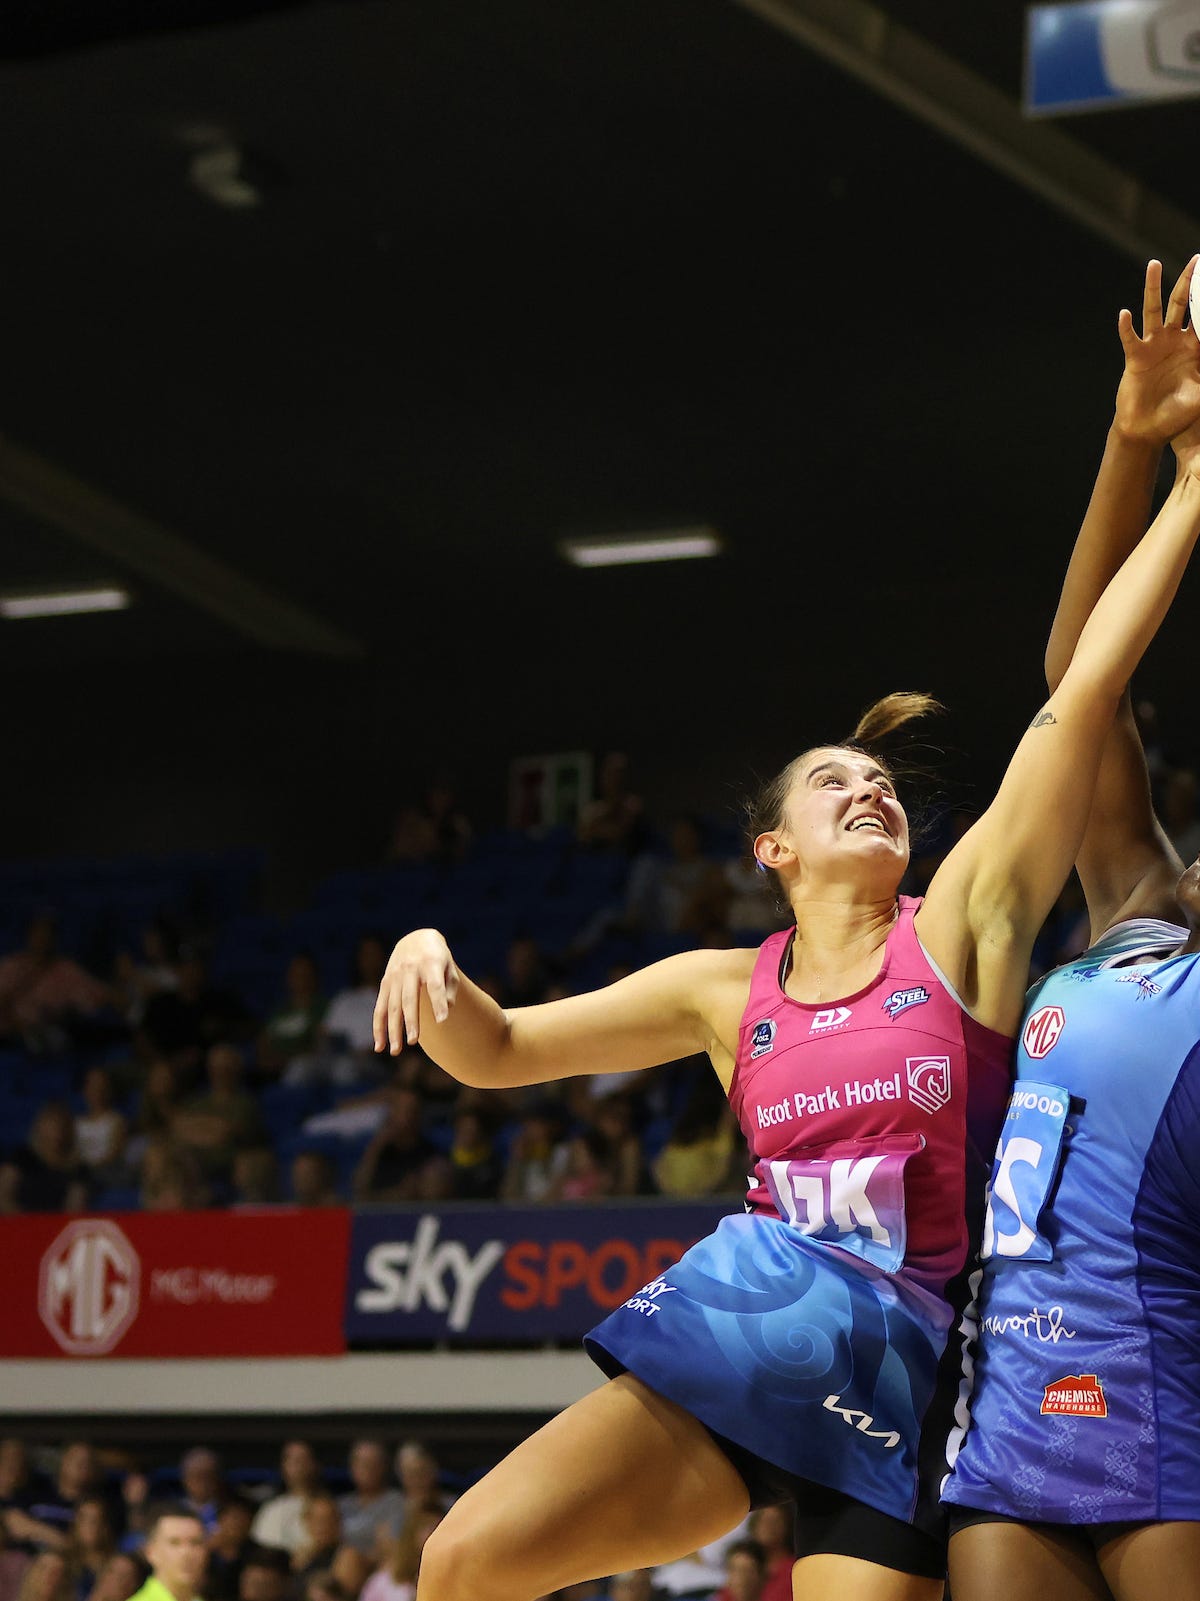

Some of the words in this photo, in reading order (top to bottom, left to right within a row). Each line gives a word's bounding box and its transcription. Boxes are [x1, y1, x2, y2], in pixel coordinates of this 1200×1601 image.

[889, 989, 929, 1011] STEEL
[1025, 1009, 1060, 1054] MG
[756, 1102, 791, 1130] Ascot
[794, 1084, 842, 1118] Park
[843, 1072, 902, 1107] Hotel
[355, 1213, 505, 1333] sky
[1045, 1402, 1102, 1412] WAREHOUSE
[1048, 1389, 1101, 1403] CHEMIST
